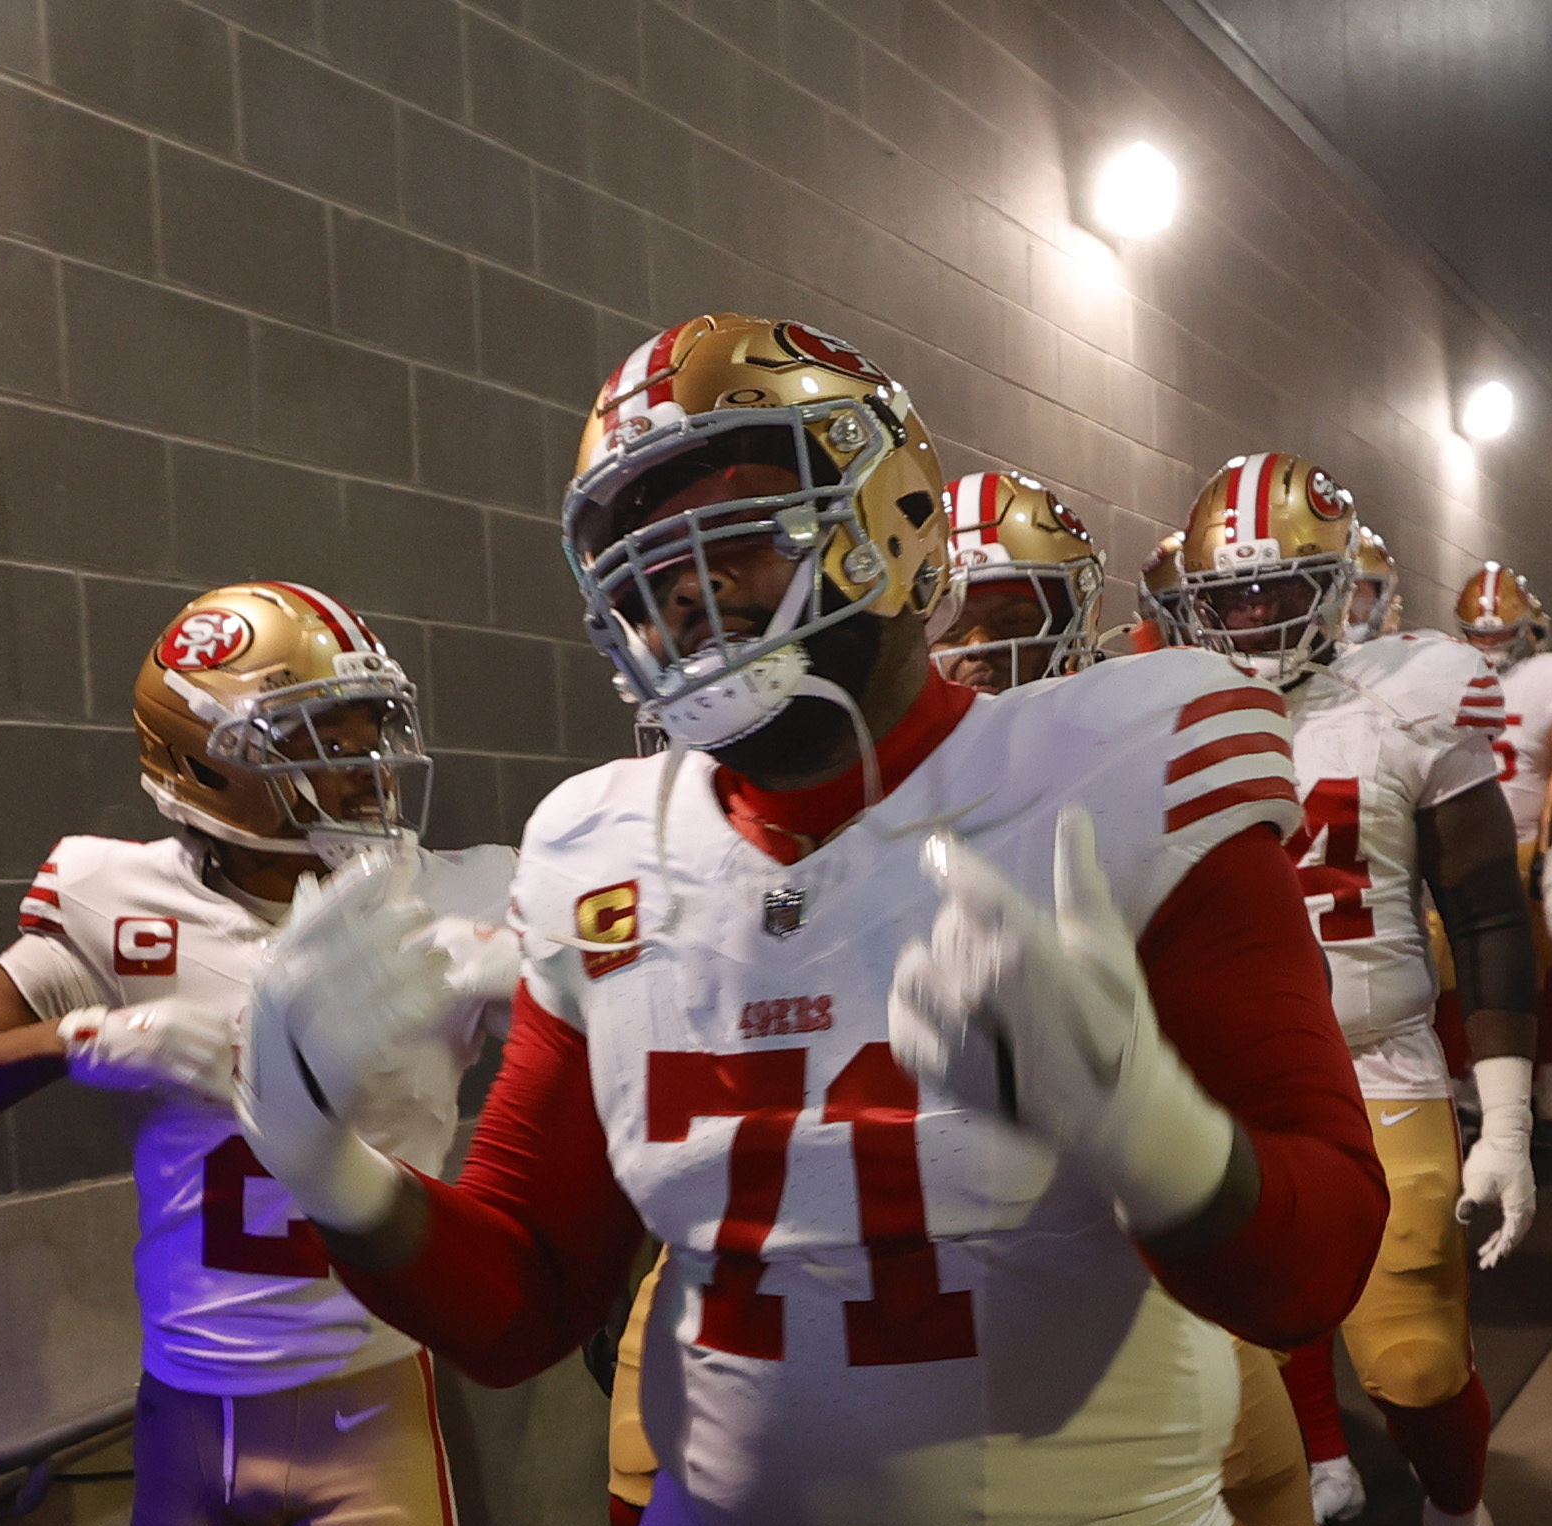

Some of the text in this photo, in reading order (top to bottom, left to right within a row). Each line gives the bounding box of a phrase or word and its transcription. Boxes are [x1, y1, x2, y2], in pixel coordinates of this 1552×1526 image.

[173, 612, 241, 666] SF
[117, 919, 174, 962] C
[577, 886, 637, 944] C
[645, 1040, 979, 1367] 71
